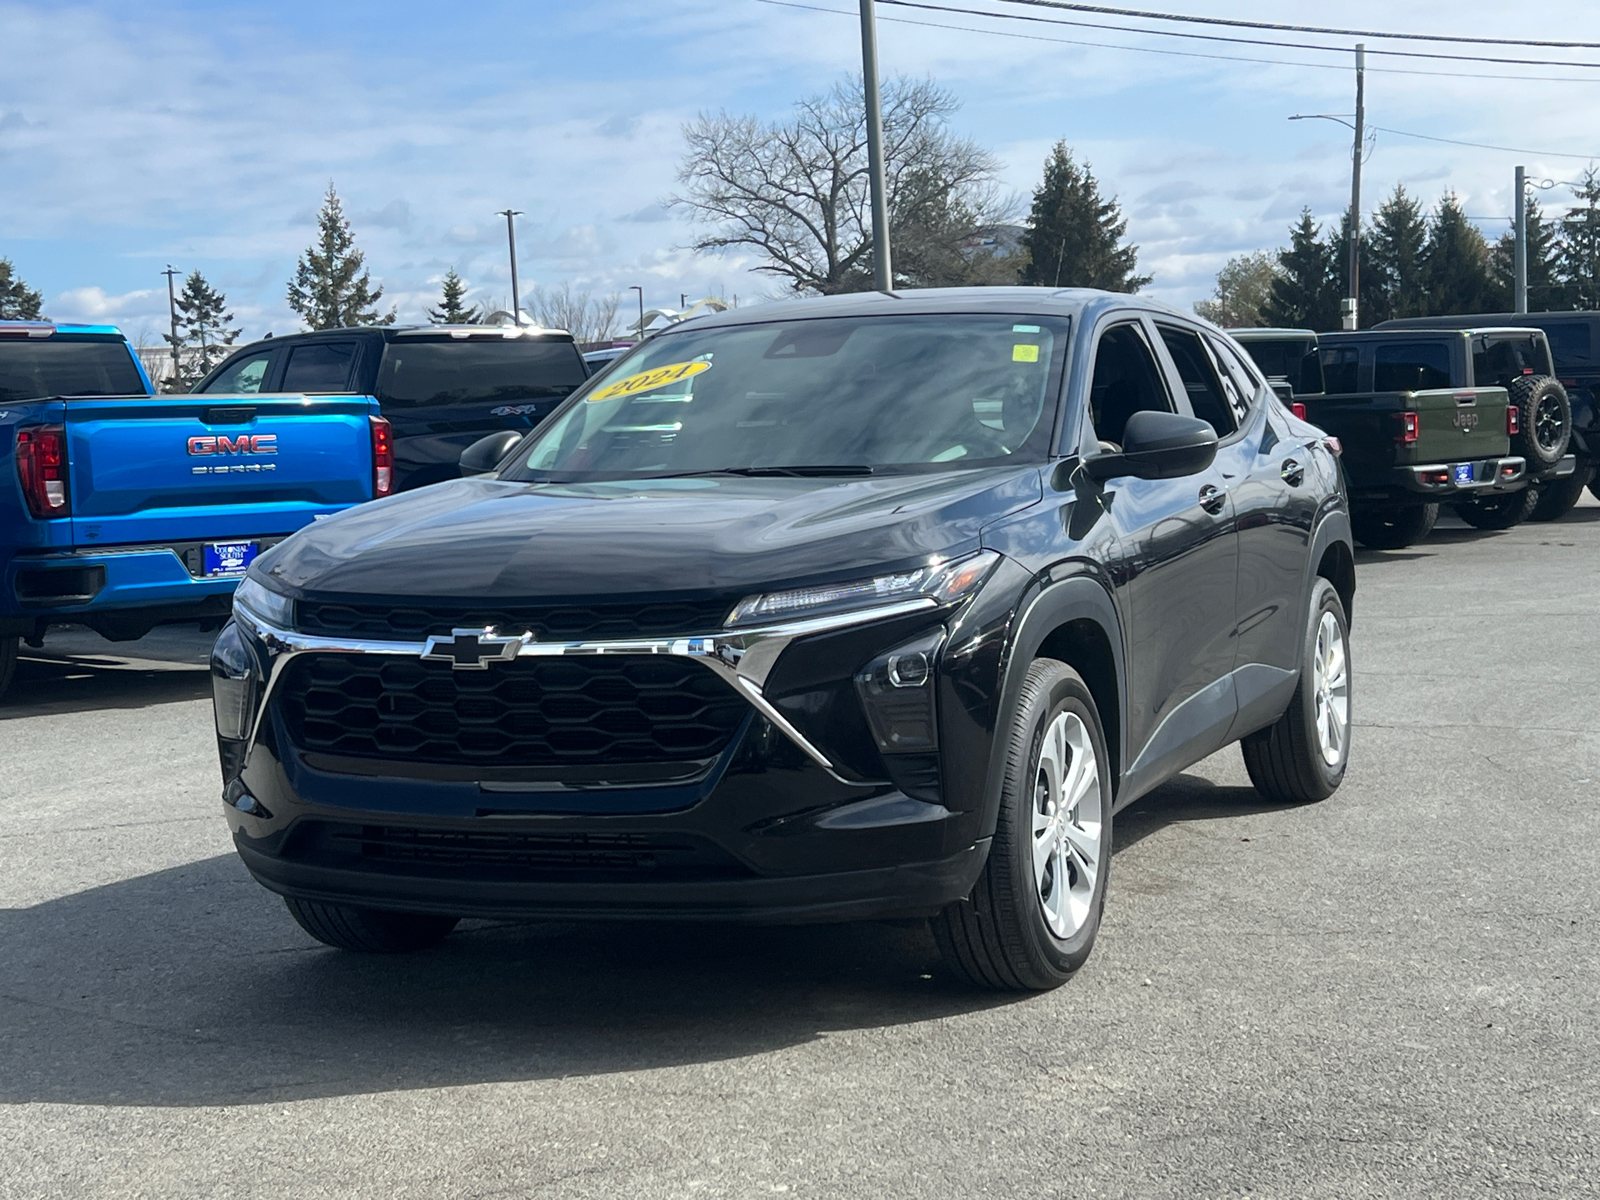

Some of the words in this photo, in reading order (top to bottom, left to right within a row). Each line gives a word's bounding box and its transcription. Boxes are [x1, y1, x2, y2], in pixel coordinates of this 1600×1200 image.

[604, 364, 693, 399] 2024
[1453, 410, 1478, 429] Jeep
[188, 434, 278, 456] GMC
[192, 464, 276, 474] SIERRA
